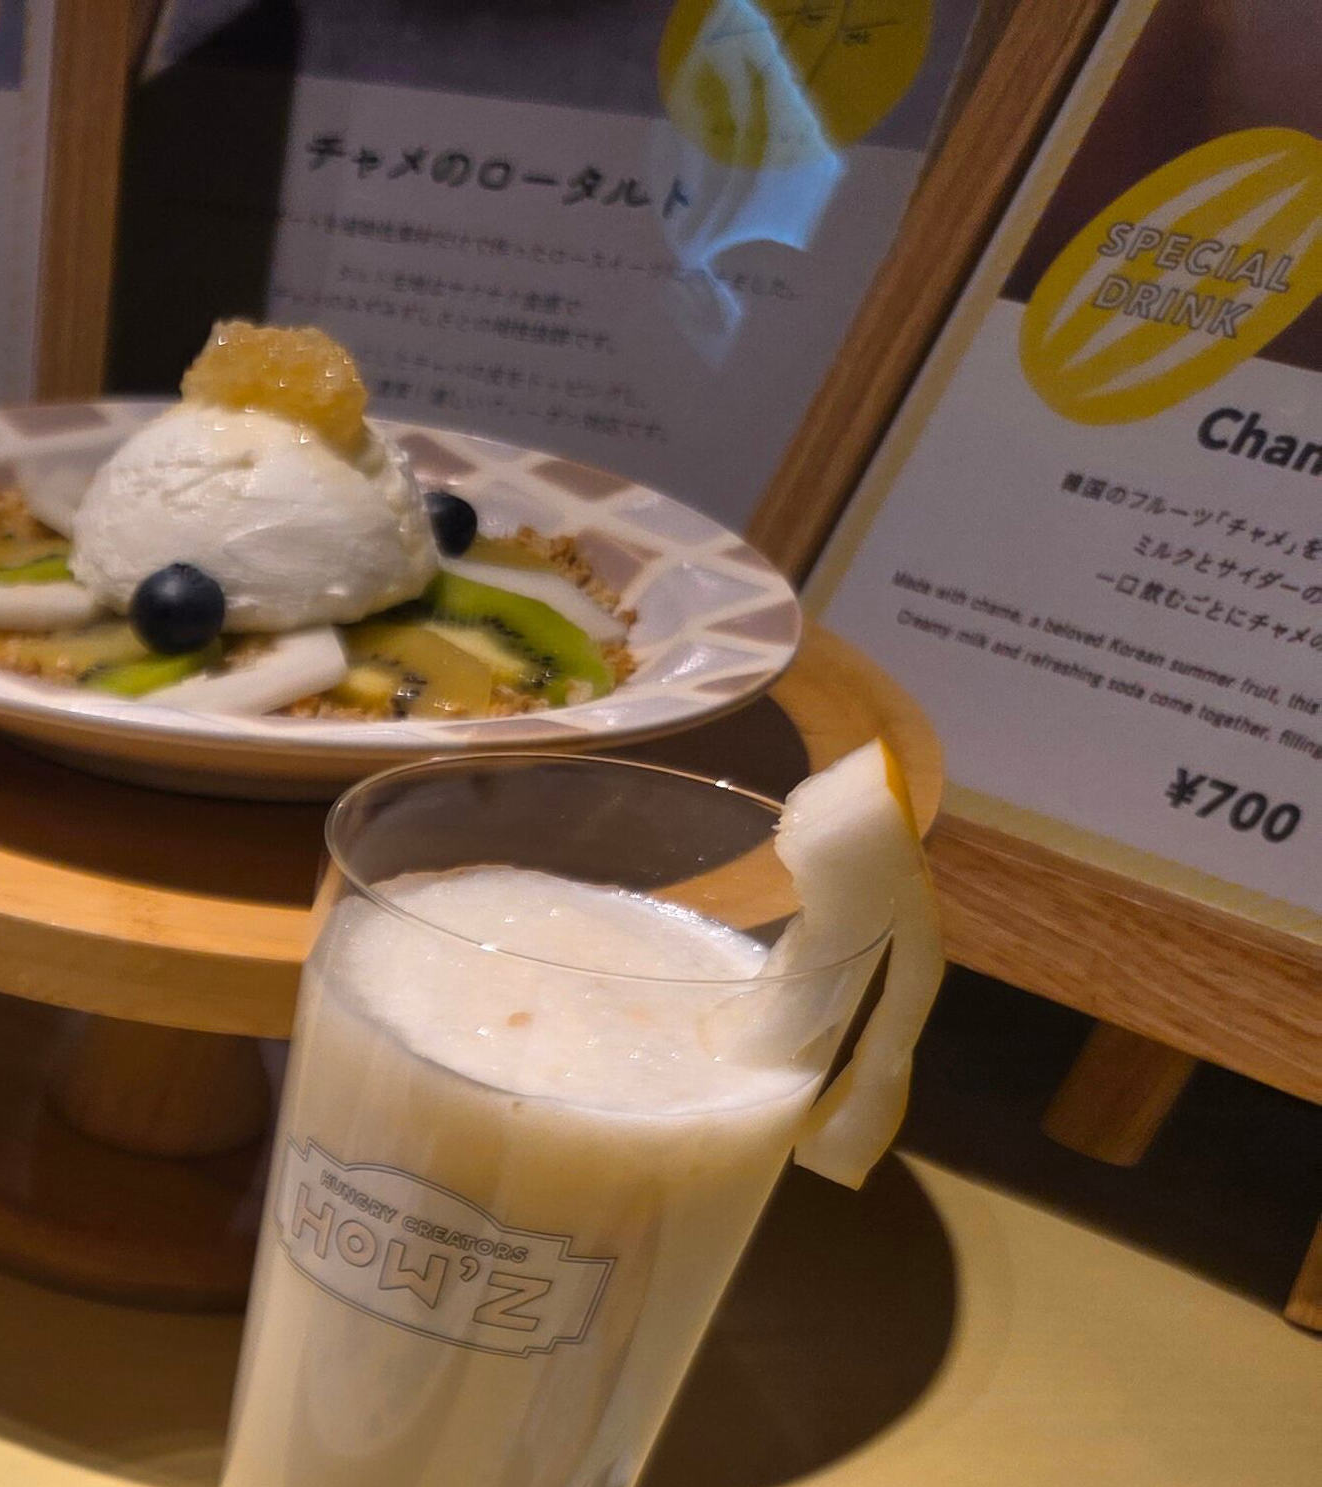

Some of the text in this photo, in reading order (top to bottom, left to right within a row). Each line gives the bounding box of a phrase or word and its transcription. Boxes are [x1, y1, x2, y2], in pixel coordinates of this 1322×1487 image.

[1098, 221, 1292, 295] SPECIAL
[1093, 274, 1254, 339] DRINK
[991, 639, 1022, 661] and
[1024, 650, 1105, 690] refreshing
[1107, 676, 1146, 700] soda
[1149, 690, 1194, 716] come
[1043, 616, 1106, 649] beloved
[1109, 636, 1167, 668] Korean
[1168, 657, 1236, 689] summer
[1287, 693, 1321, 716] this
[1165, 767, 1303, 844] ¥700
[319, 1168, 529, 1264] HUNGRY CREATORS
